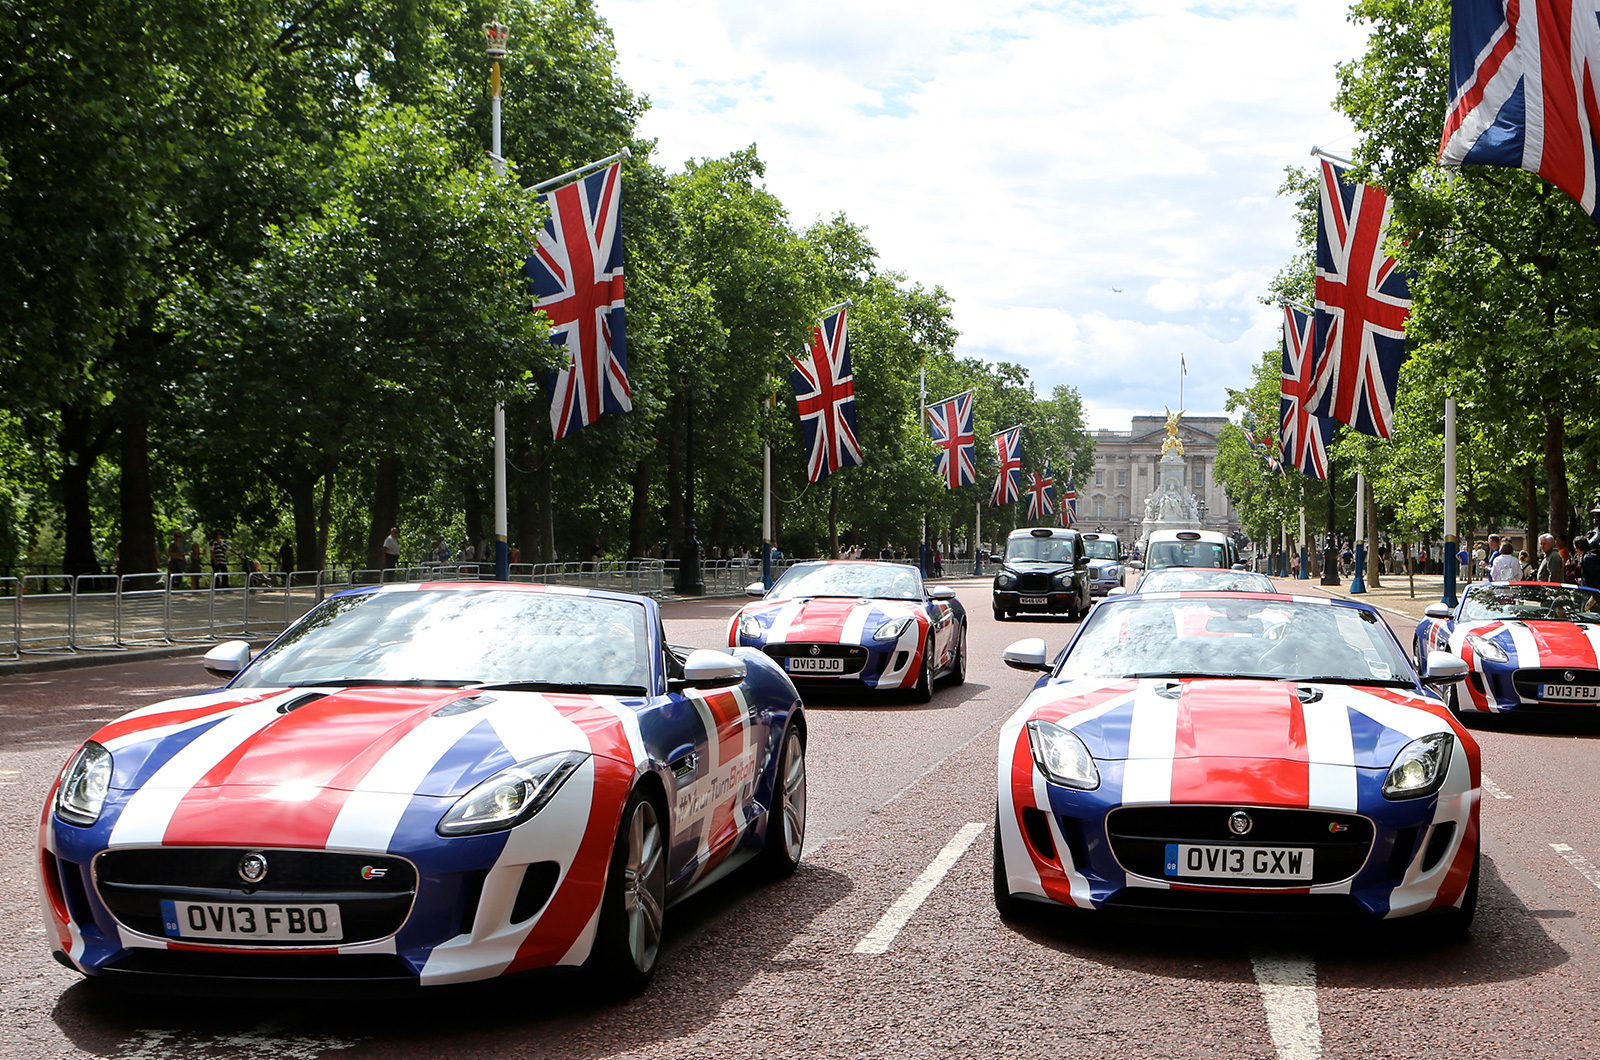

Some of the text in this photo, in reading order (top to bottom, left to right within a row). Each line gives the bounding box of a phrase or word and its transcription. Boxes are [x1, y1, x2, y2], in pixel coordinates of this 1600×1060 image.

[793, 659, 839, 670] OV13 DJO
[1547, 685, 1597, 698] OV13 FBJ
[1187, 847, 1303, 875] OV13 GXW
[166, 922, 178, 930] GB
[187, 905, 328, 934] OV13 FBO
